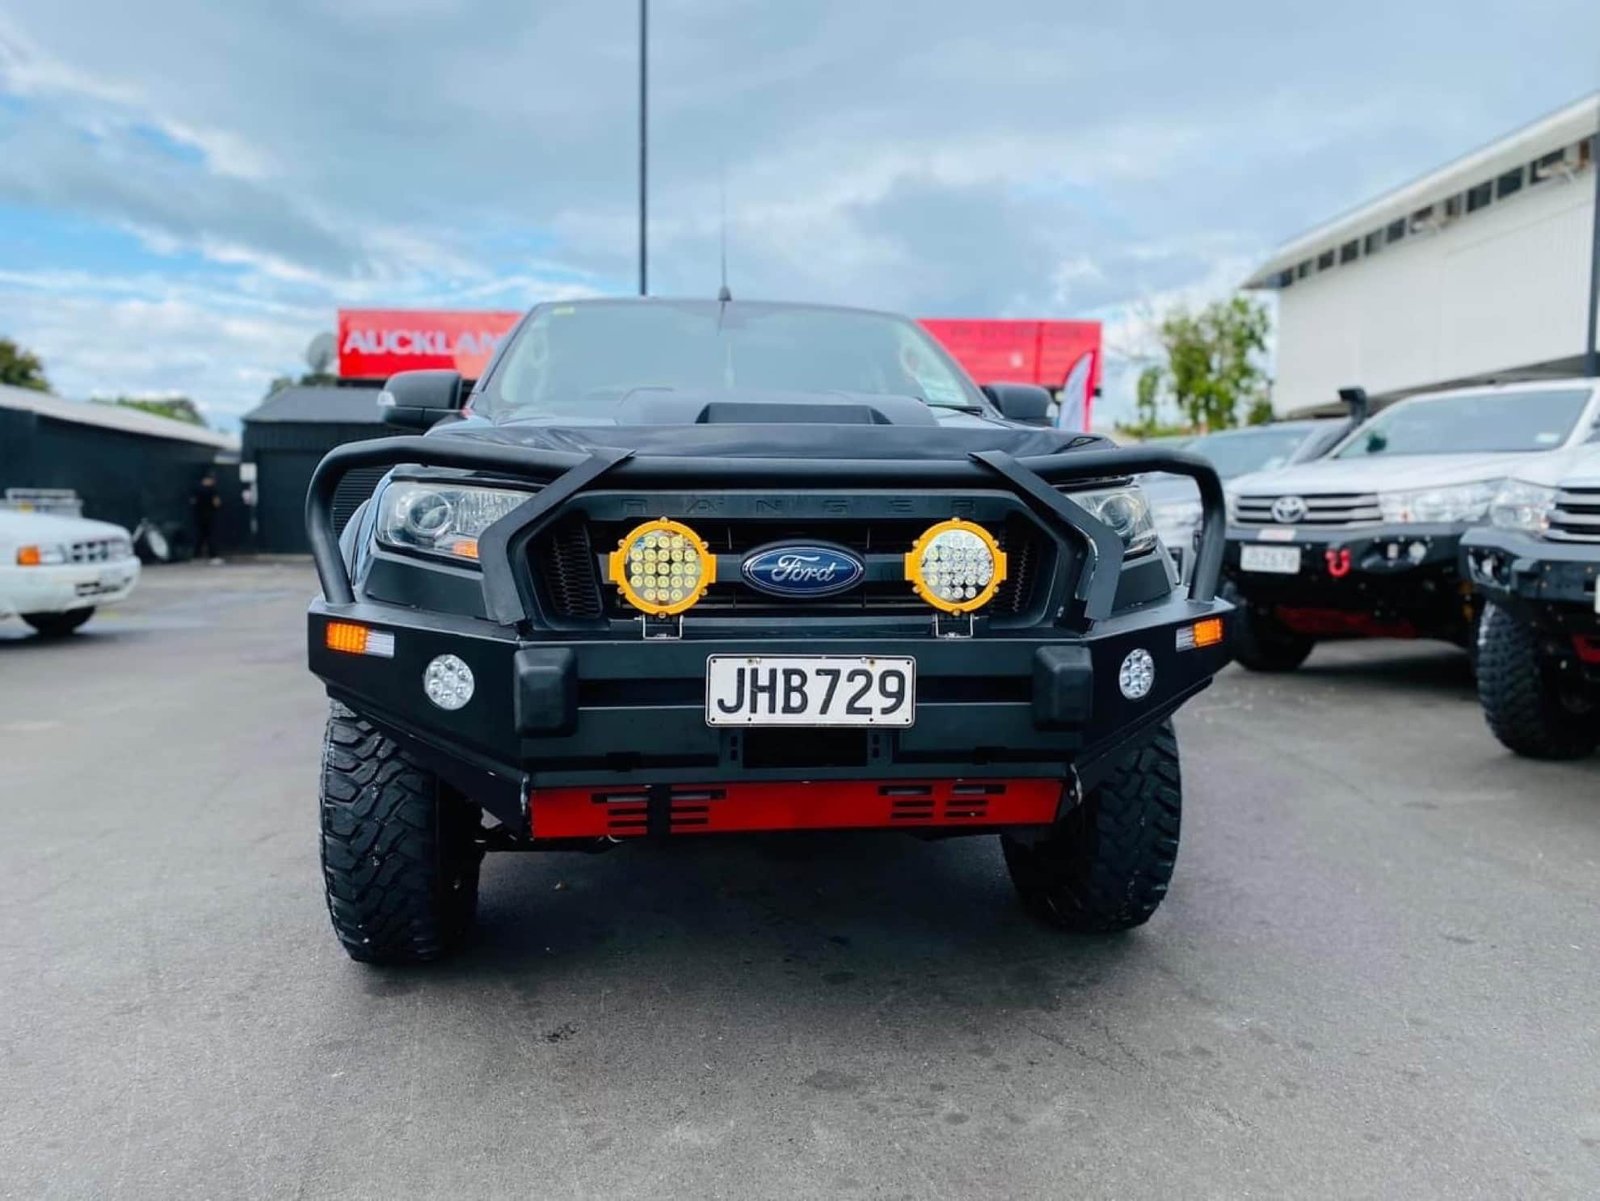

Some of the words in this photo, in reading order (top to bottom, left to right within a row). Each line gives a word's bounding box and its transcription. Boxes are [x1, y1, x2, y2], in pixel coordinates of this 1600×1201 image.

[620, 498, 976, 515] RANGER
[771, 554, 836, 583] Ford
[716, 667, 906, 716] JHB729
